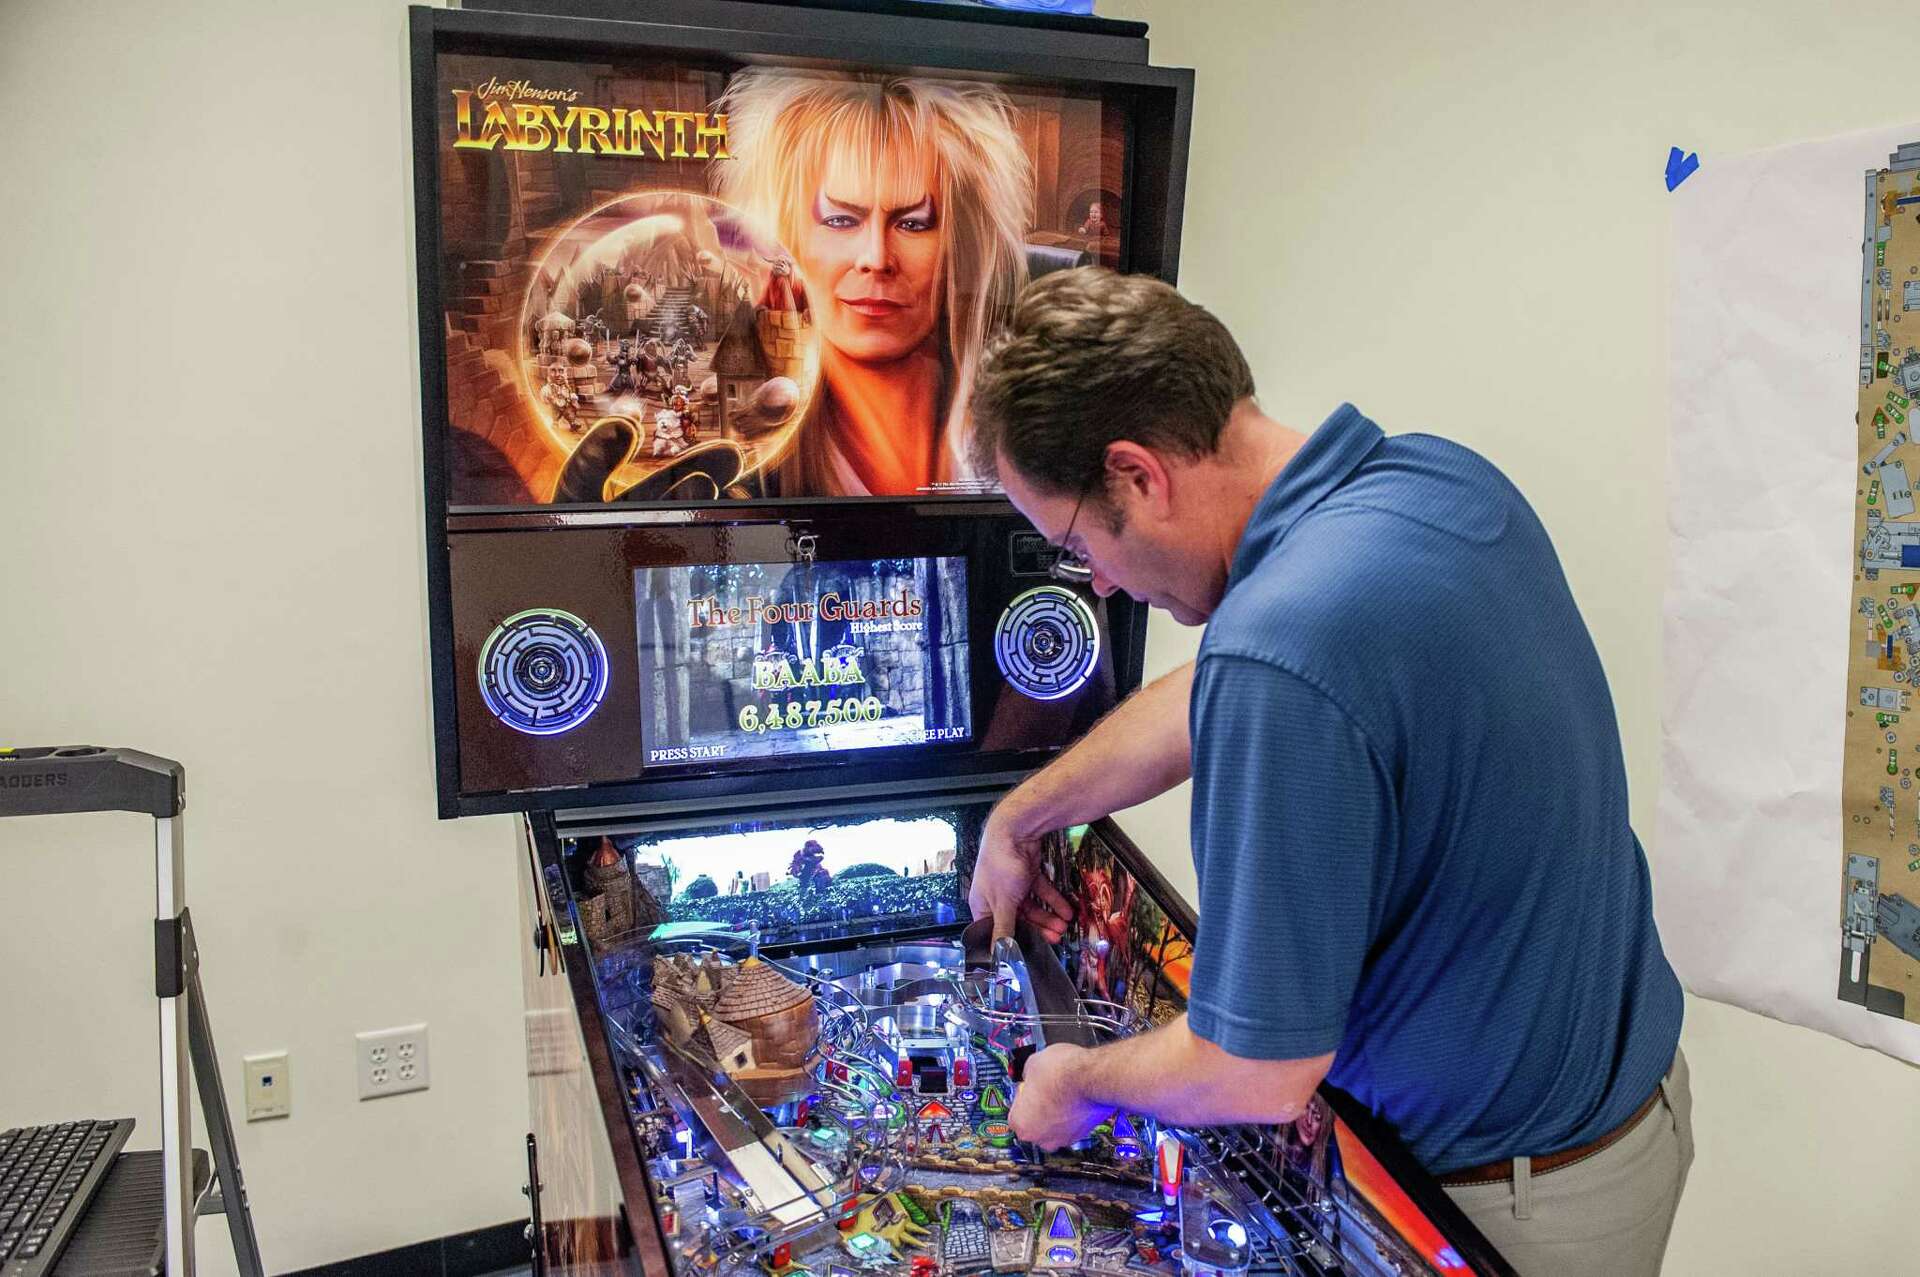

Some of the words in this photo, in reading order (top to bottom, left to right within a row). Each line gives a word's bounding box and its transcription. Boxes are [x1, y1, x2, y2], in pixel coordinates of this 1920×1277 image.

[477, 76, 509, 101] Jim
[508, 80, 580, 102] Henson's
[452, 89, 731, 161] LABYRINTH
[687, 595, 742, 628] The
[748, 596, 815, 624] Four
[820, 588, 922, 620] Guards
[850, 620, 892, 636] Highest
[893, 619, 923, 632] Score
[753, 655, 865, 691] BAABA
[739, 697, 882, 734] 6,487,500
[938, 726, 965, 740] PLAY
[650, 747, 689, 762] PRESS
[689, 745, 726, 759] START
